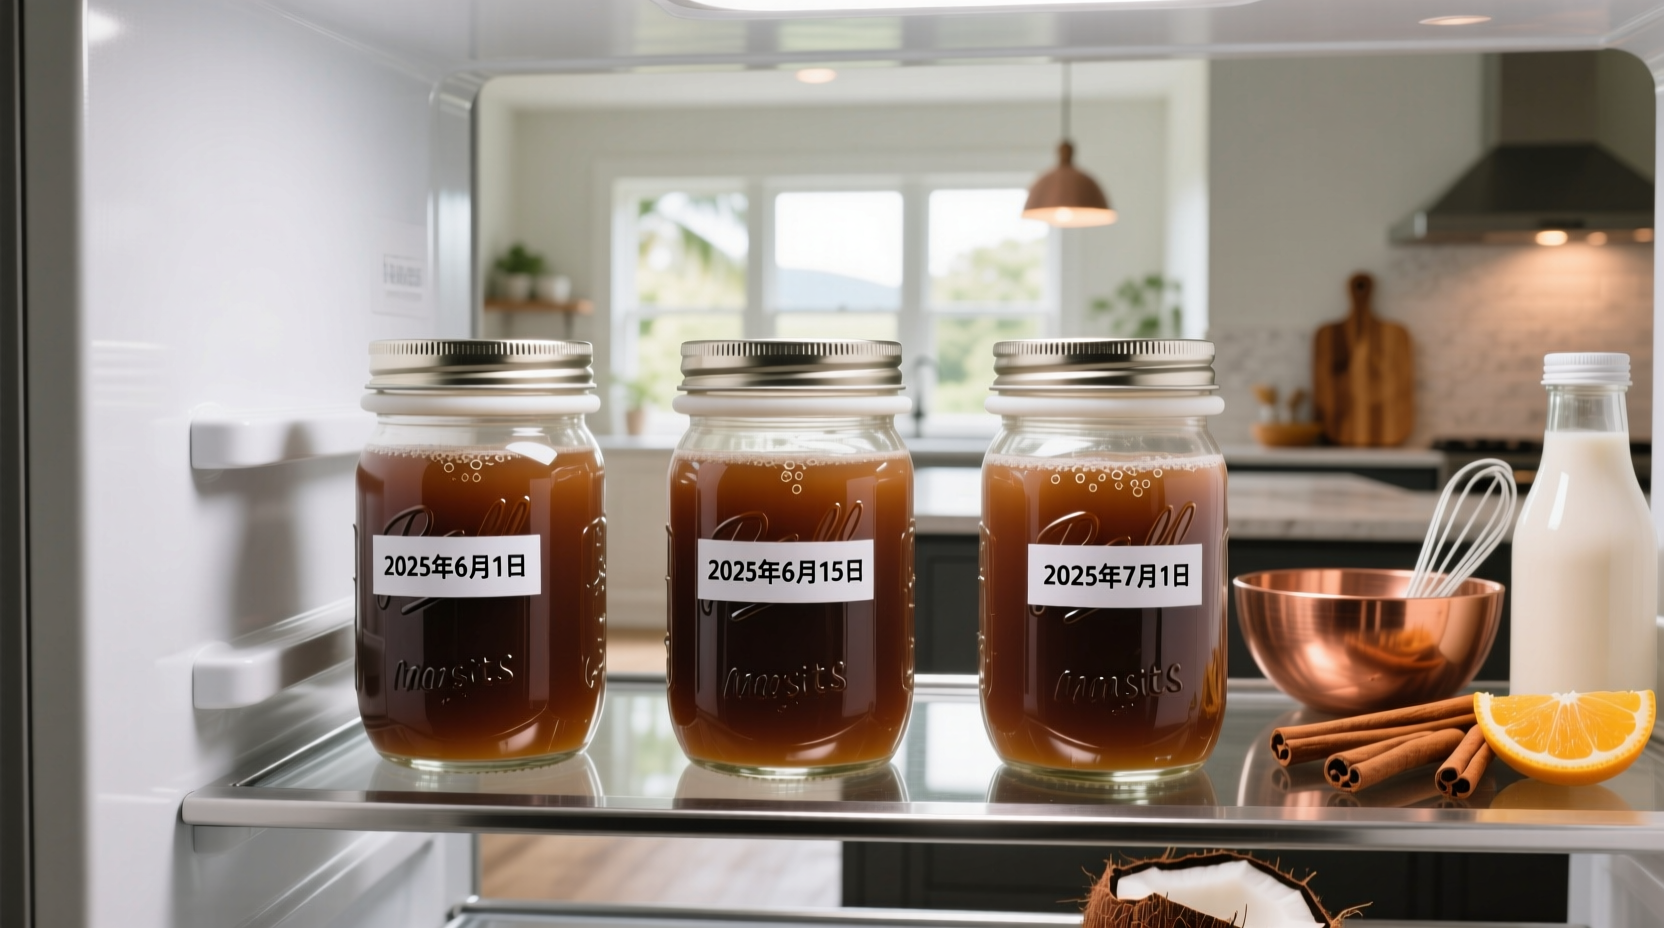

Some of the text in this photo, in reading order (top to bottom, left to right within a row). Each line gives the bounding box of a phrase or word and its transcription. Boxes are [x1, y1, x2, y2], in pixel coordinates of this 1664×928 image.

[383, 553, 526, 580] 2025年6月1日
[707, 558, 863, 585] 2025年6月15日
[1043, 562, 1190, 589] 2025年7月1日
